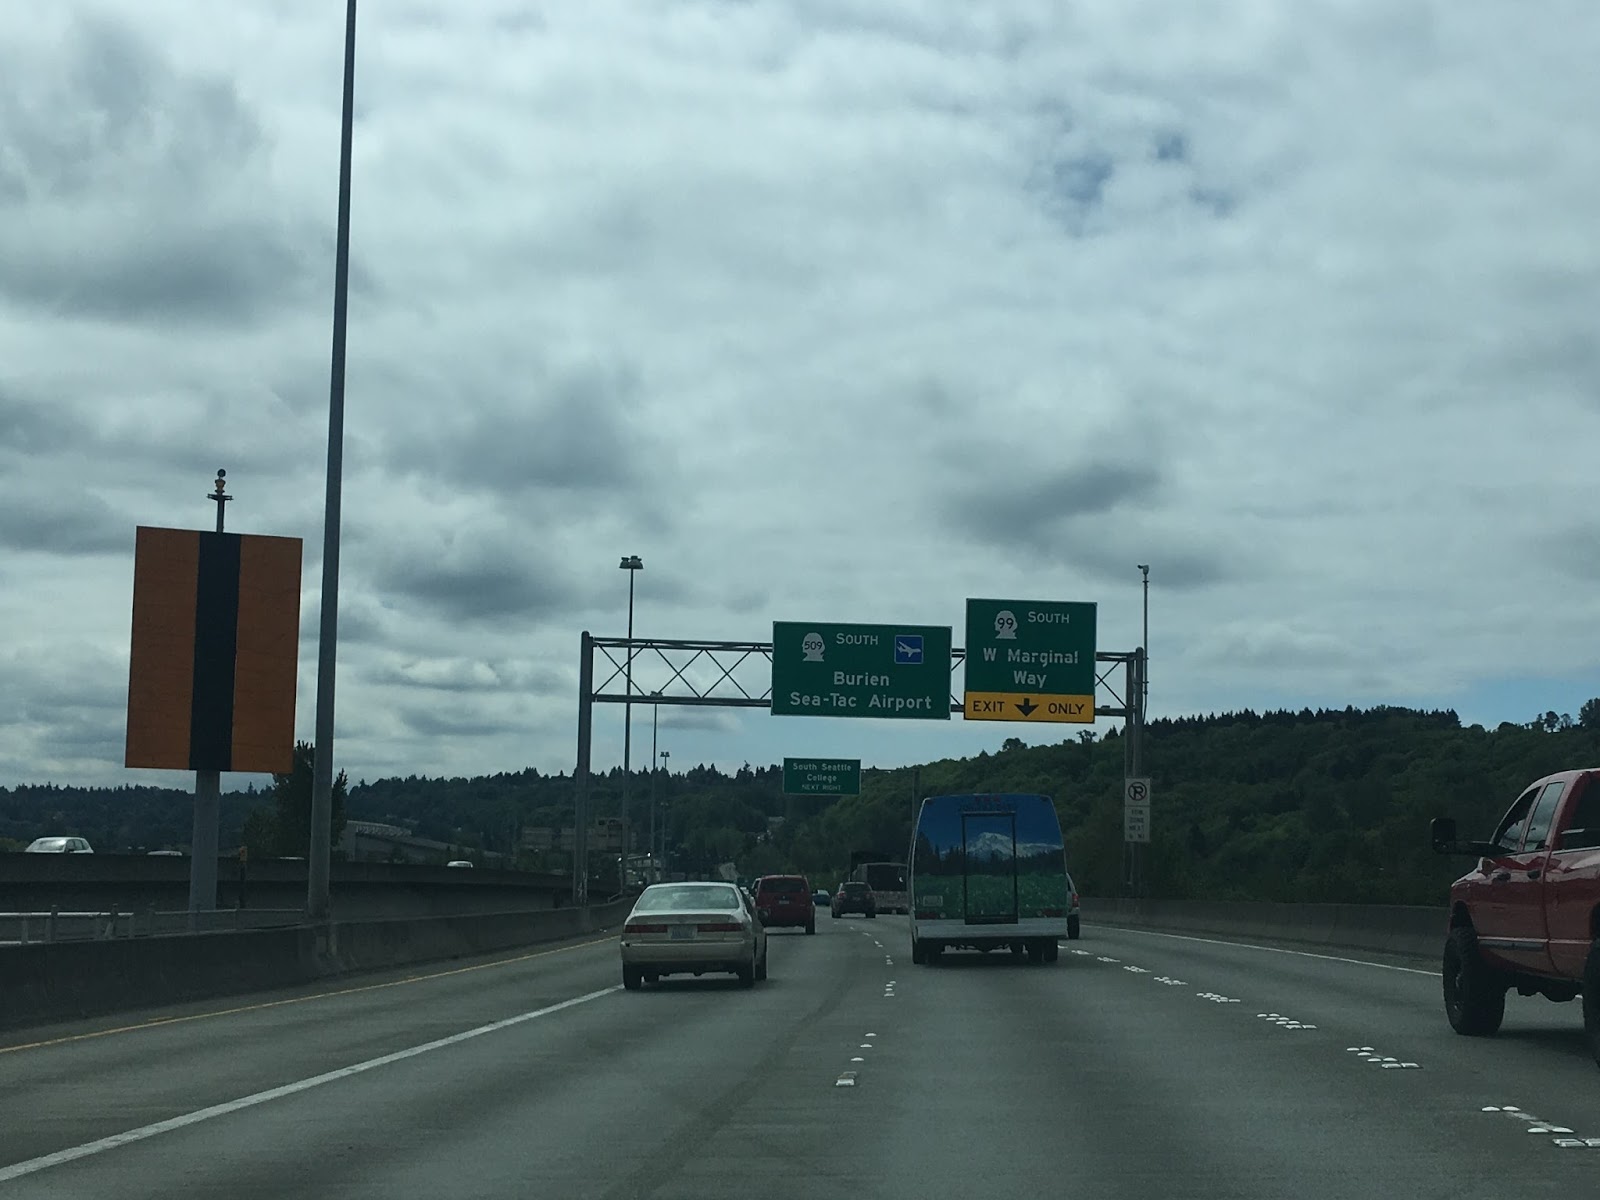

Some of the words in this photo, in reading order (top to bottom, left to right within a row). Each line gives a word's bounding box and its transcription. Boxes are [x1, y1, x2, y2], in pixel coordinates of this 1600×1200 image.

[997, 617, 1014, 629] 99
[1027, 611, 1070, 623] SOUTH
[804, 640, 823, 650] 509
[836, 632, 879, 645] SOUTH
[983, 647, 997, 661] W
[1007, 648, 1079, 667] Marginal
[833, 671, 890, 686] Burien
[1013, 670, 1047, 688] Way
[790, 691, 857, 707] Sea-Tac
[868, 694, 932, 711] Airport
[972, 700, 1005, 712] EXIT
[1048, 702, 1085, 715] ONLY
[792, 762, 817, 771] South
[821, 763, 852, 772] Seattle
[806, 773, 837, 784] College
